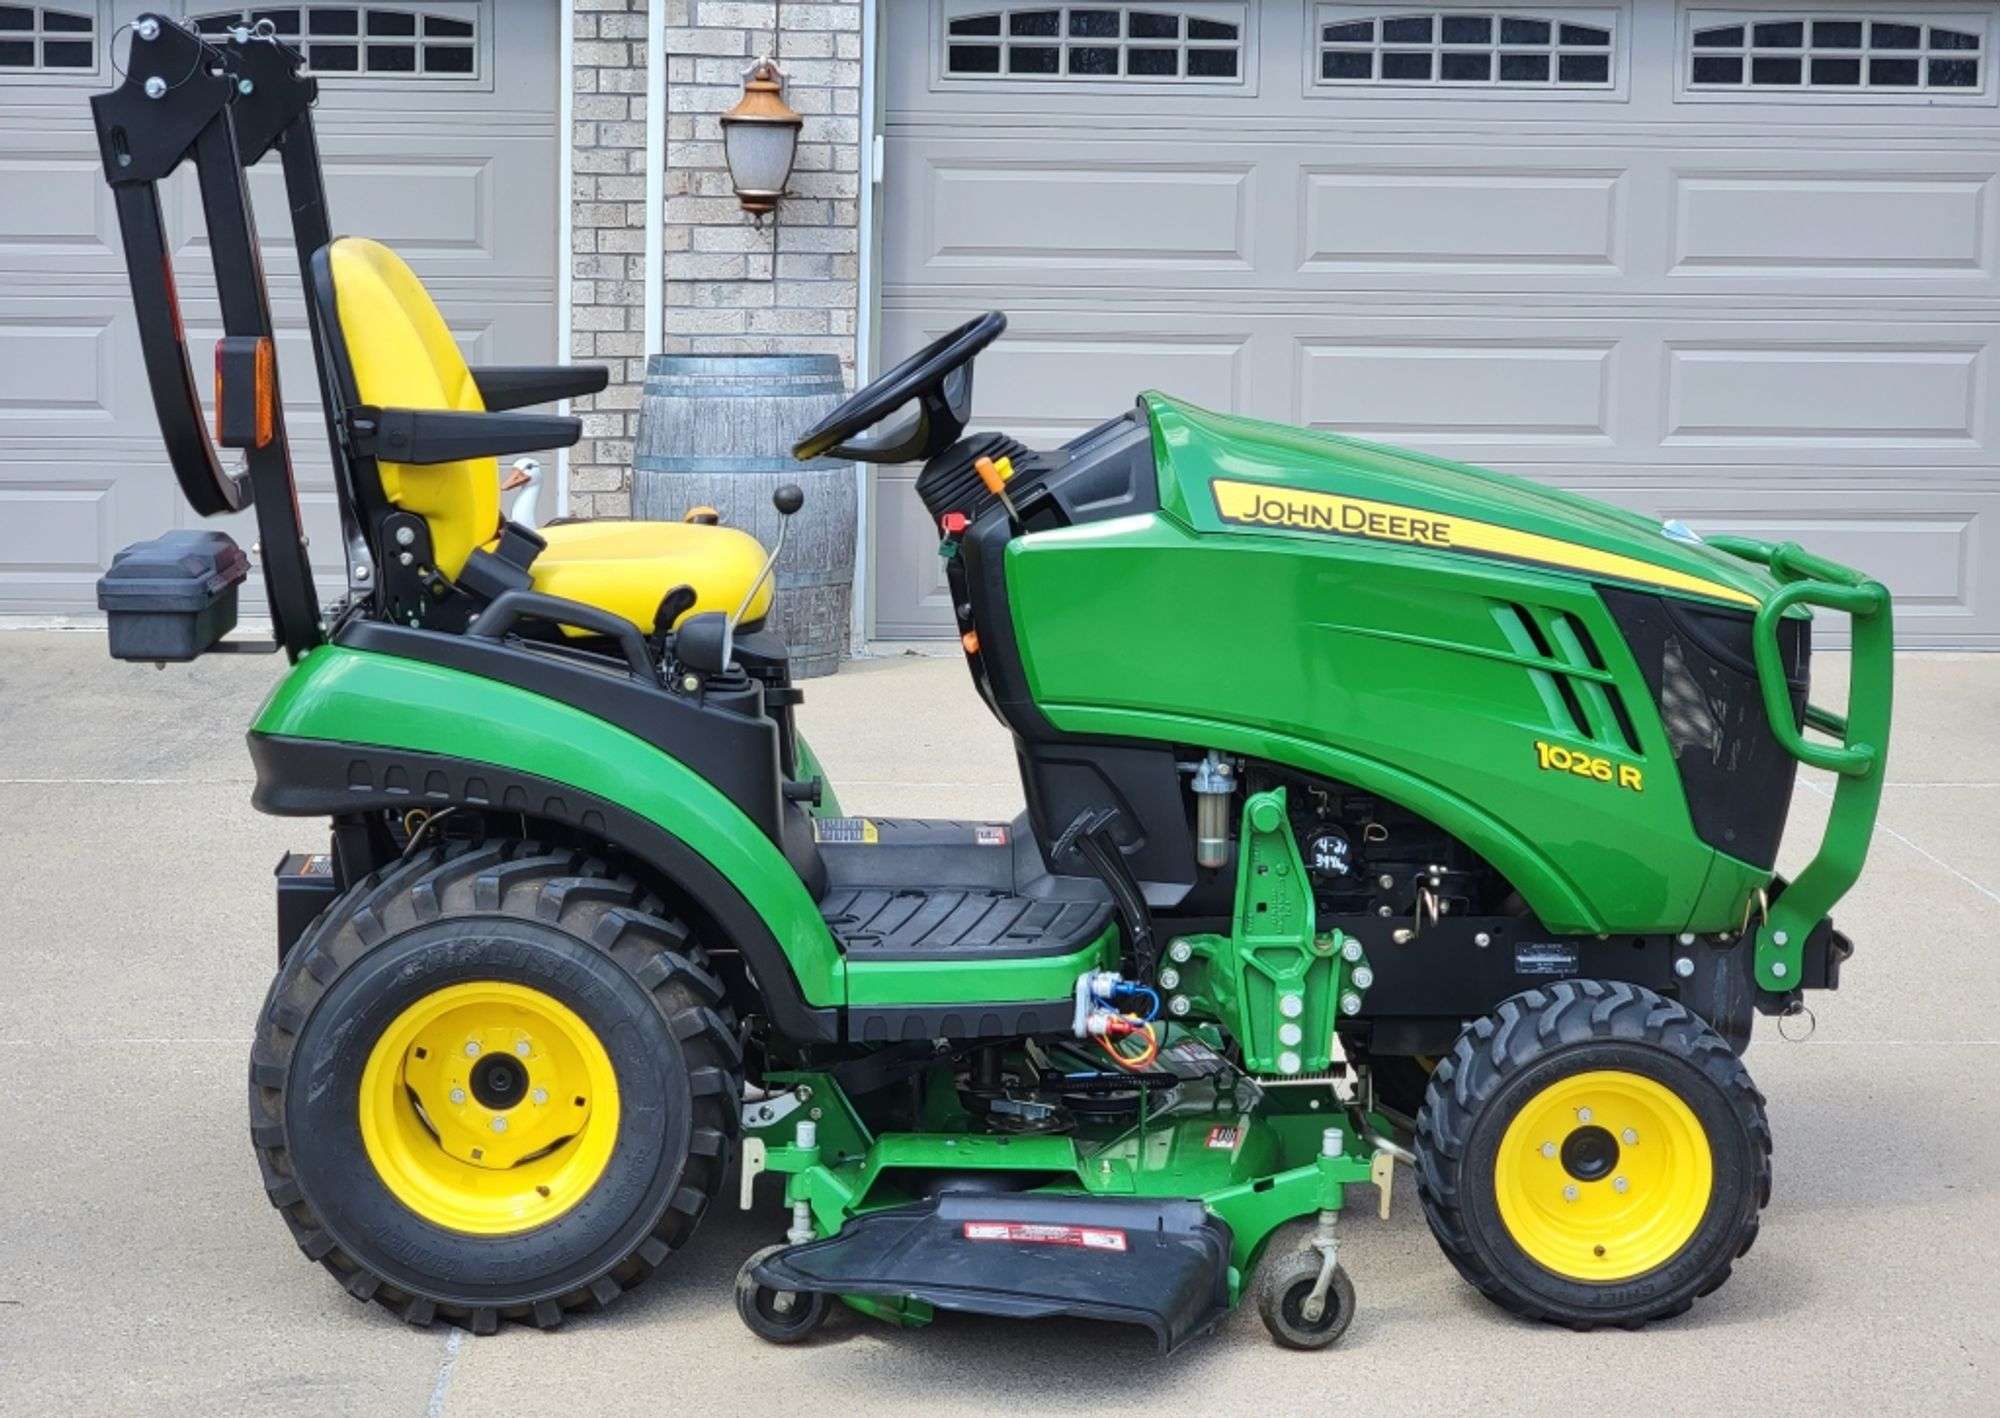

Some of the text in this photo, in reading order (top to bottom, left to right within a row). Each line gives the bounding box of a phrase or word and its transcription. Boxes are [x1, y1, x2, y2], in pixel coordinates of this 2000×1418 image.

[1243, 494, 1451, 544] JOHN DEERE
[1534, 740, 1644, 792] 1026 R
